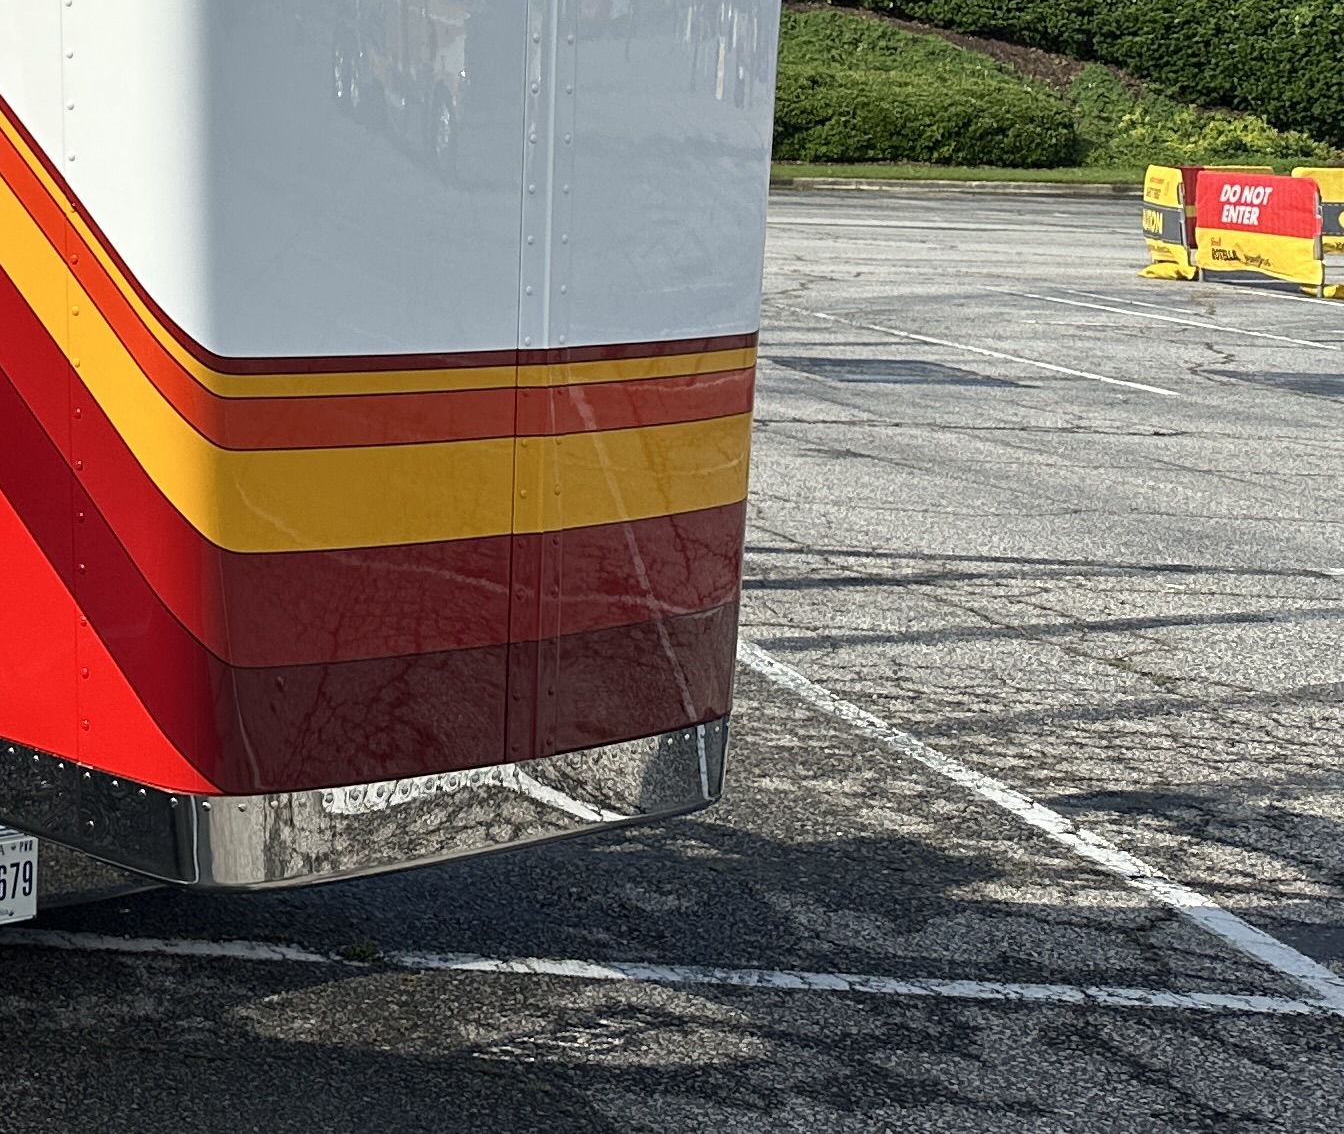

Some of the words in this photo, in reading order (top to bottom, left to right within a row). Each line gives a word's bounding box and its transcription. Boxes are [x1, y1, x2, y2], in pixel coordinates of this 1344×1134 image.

[1219, 184, 1242, 203] DO
[1241, 185, 1273, 206] NOT
[1221, 204, 1260, 226] ENTER
